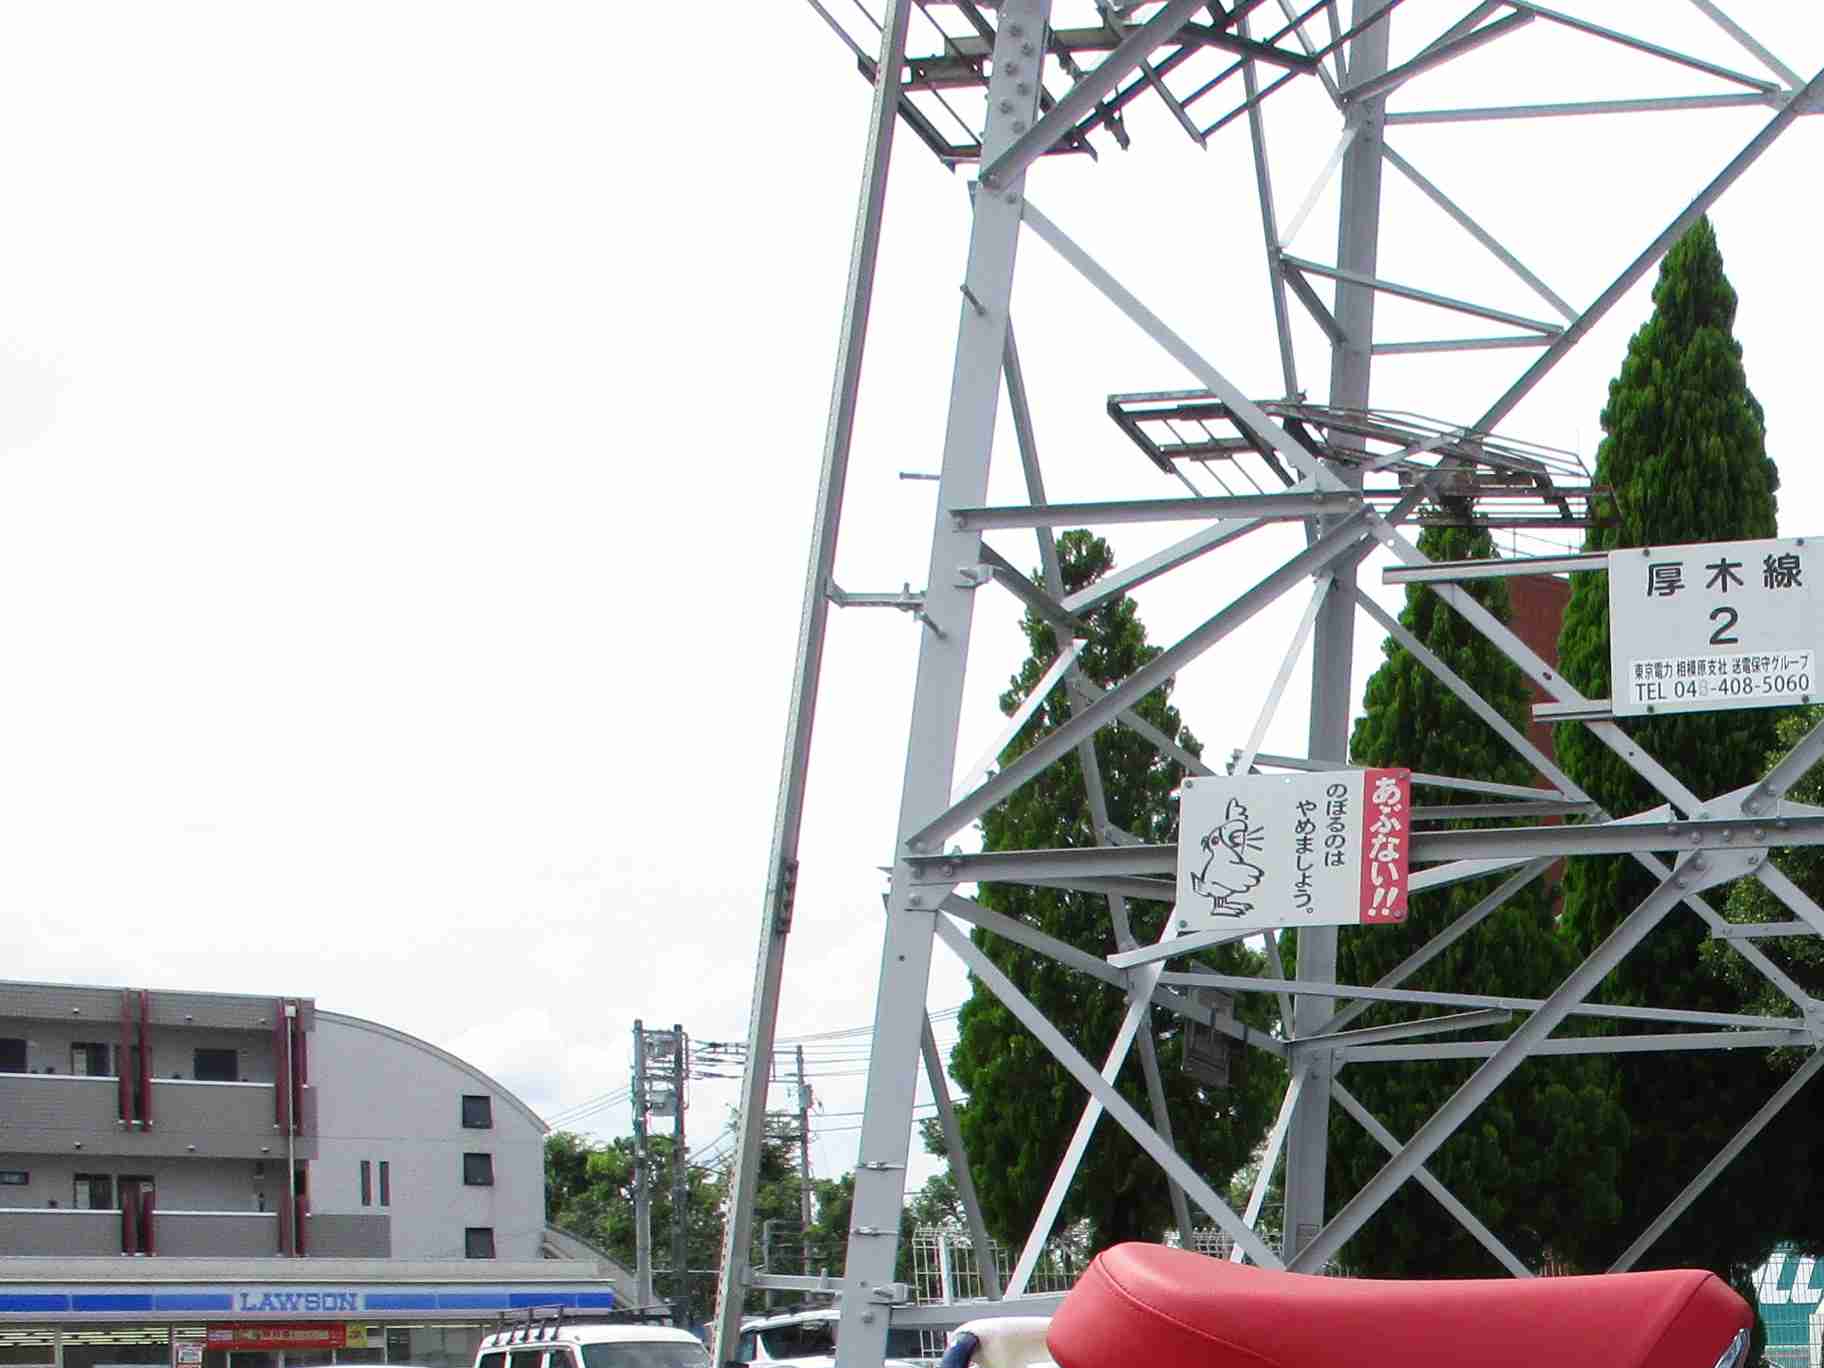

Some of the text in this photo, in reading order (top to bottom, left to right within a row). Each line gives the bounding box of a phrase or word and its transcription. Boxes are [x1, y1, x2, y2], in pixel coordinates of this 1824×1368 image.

[1647, 553, 1803, 597] 厚木線
[1709, 606, 1739, 646] 2
[1634, 661, 1673, 681] 東京電力
[1635, 682, 1667, 702] TEL
[1324, 783, 1349, 867] のぼるのは
[1293, 800, 1318, 914] やめましょう。
[239, 1291, 358, 1312] LAWSON
